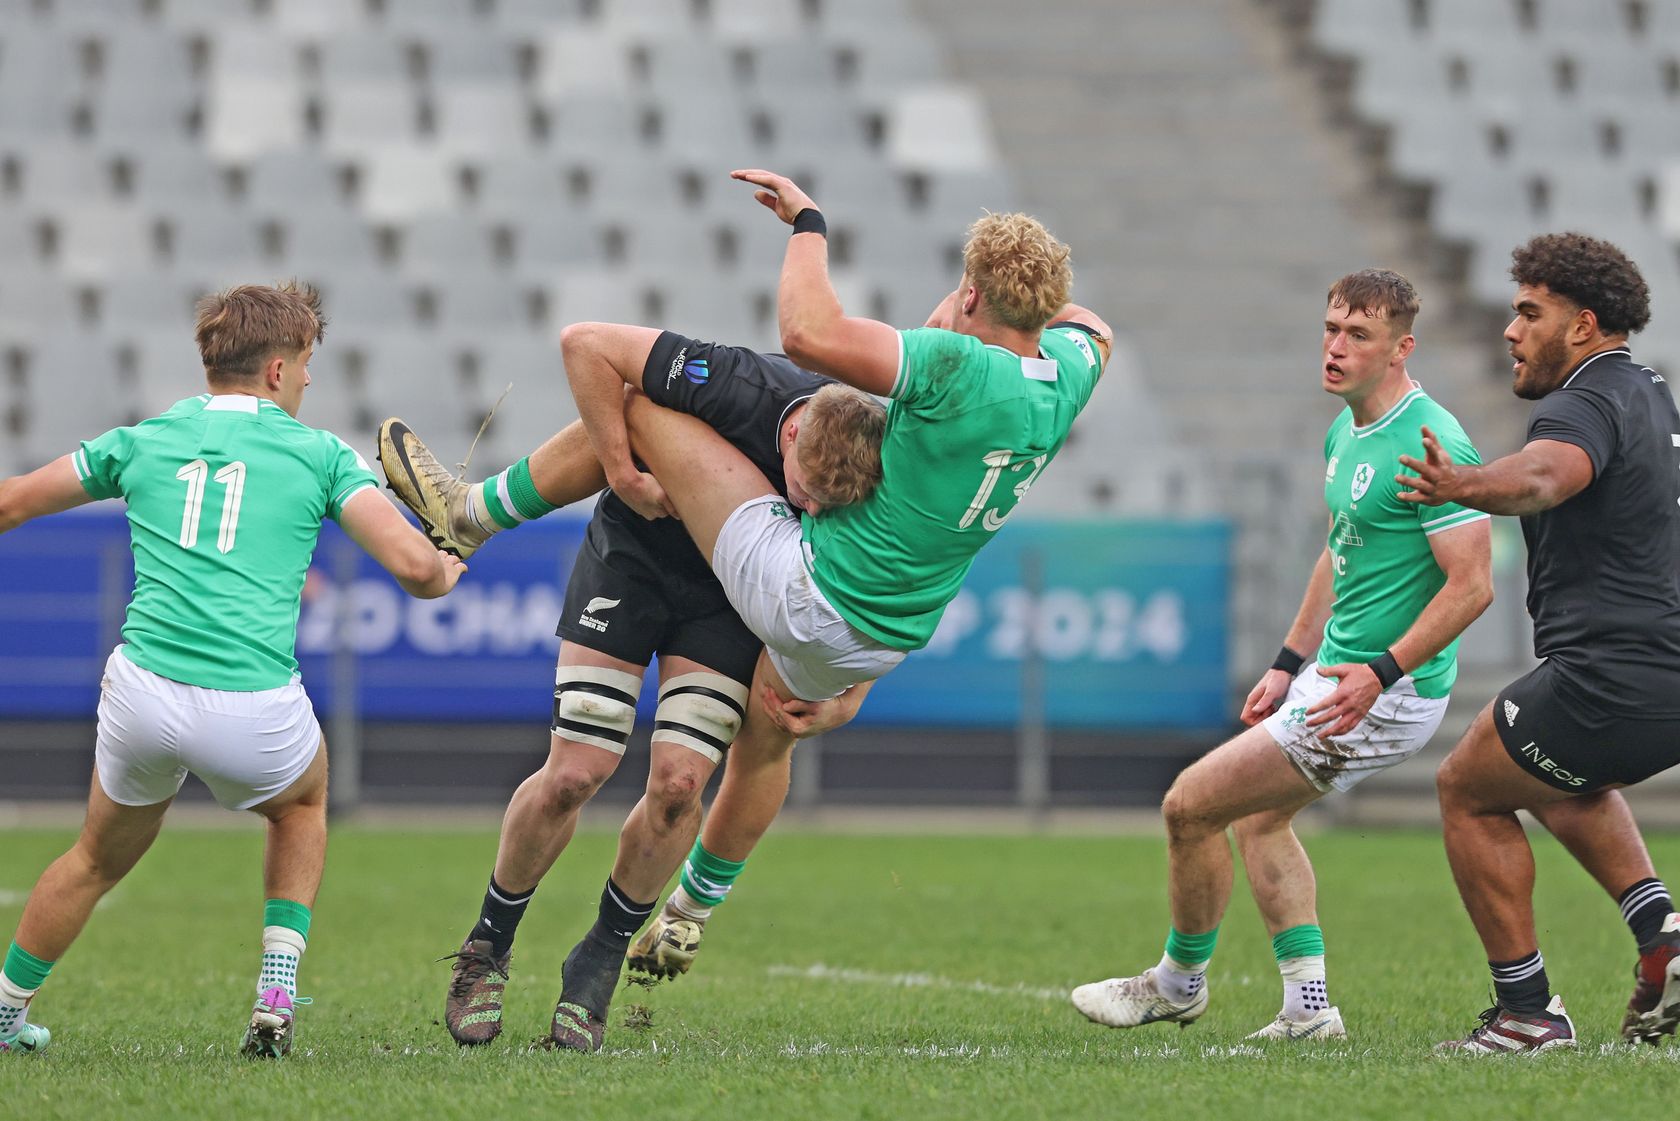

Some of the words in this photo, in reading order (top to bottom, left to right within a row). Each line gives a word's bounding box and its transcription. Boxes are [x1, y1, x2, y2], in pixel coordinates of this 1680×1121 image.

[176, 458, 247, 555] 11
[959, 449, 1047, 532] 13
[987, 584, 1188, 660] 2024
[1521, 741, 1587, 786] INEOS
